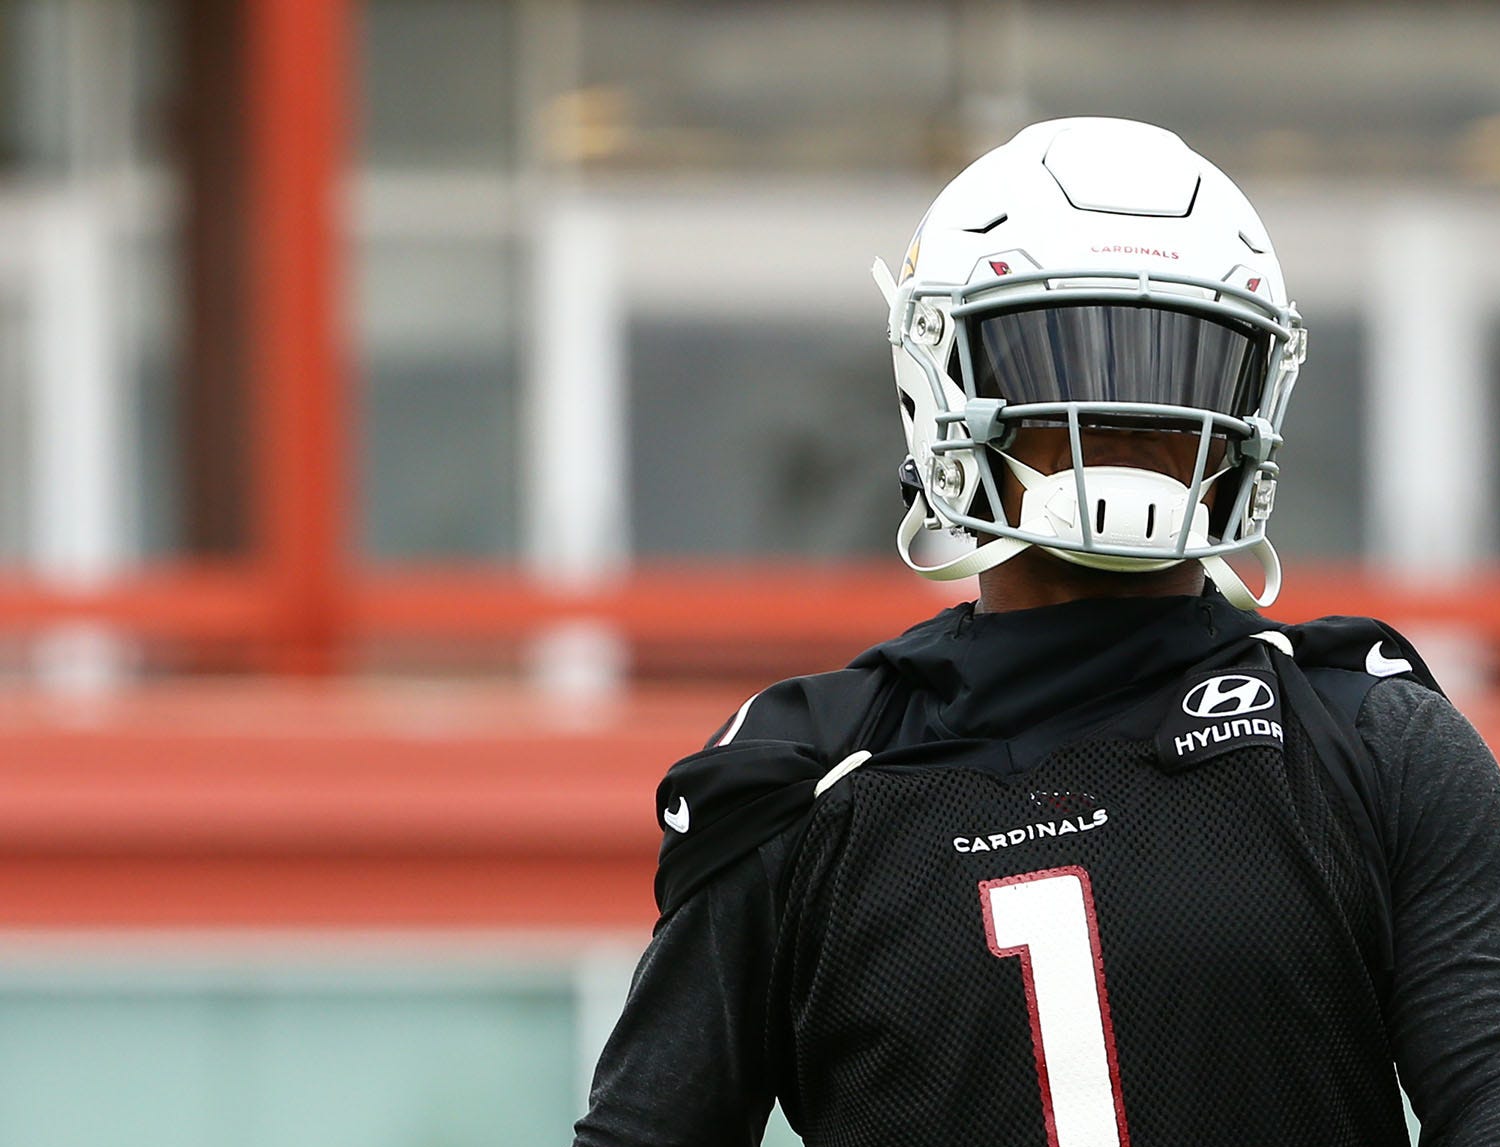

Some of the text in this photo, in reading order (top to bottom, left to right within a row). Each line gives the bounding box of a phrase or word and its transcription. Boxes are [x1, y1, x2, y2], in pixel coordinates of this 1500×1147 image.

[1090, 245, 1180, 260] CARDINALS
[1174, 718, 1284, 756] HYUNDA
[953, 808, 1108, 854] CARDINALS
